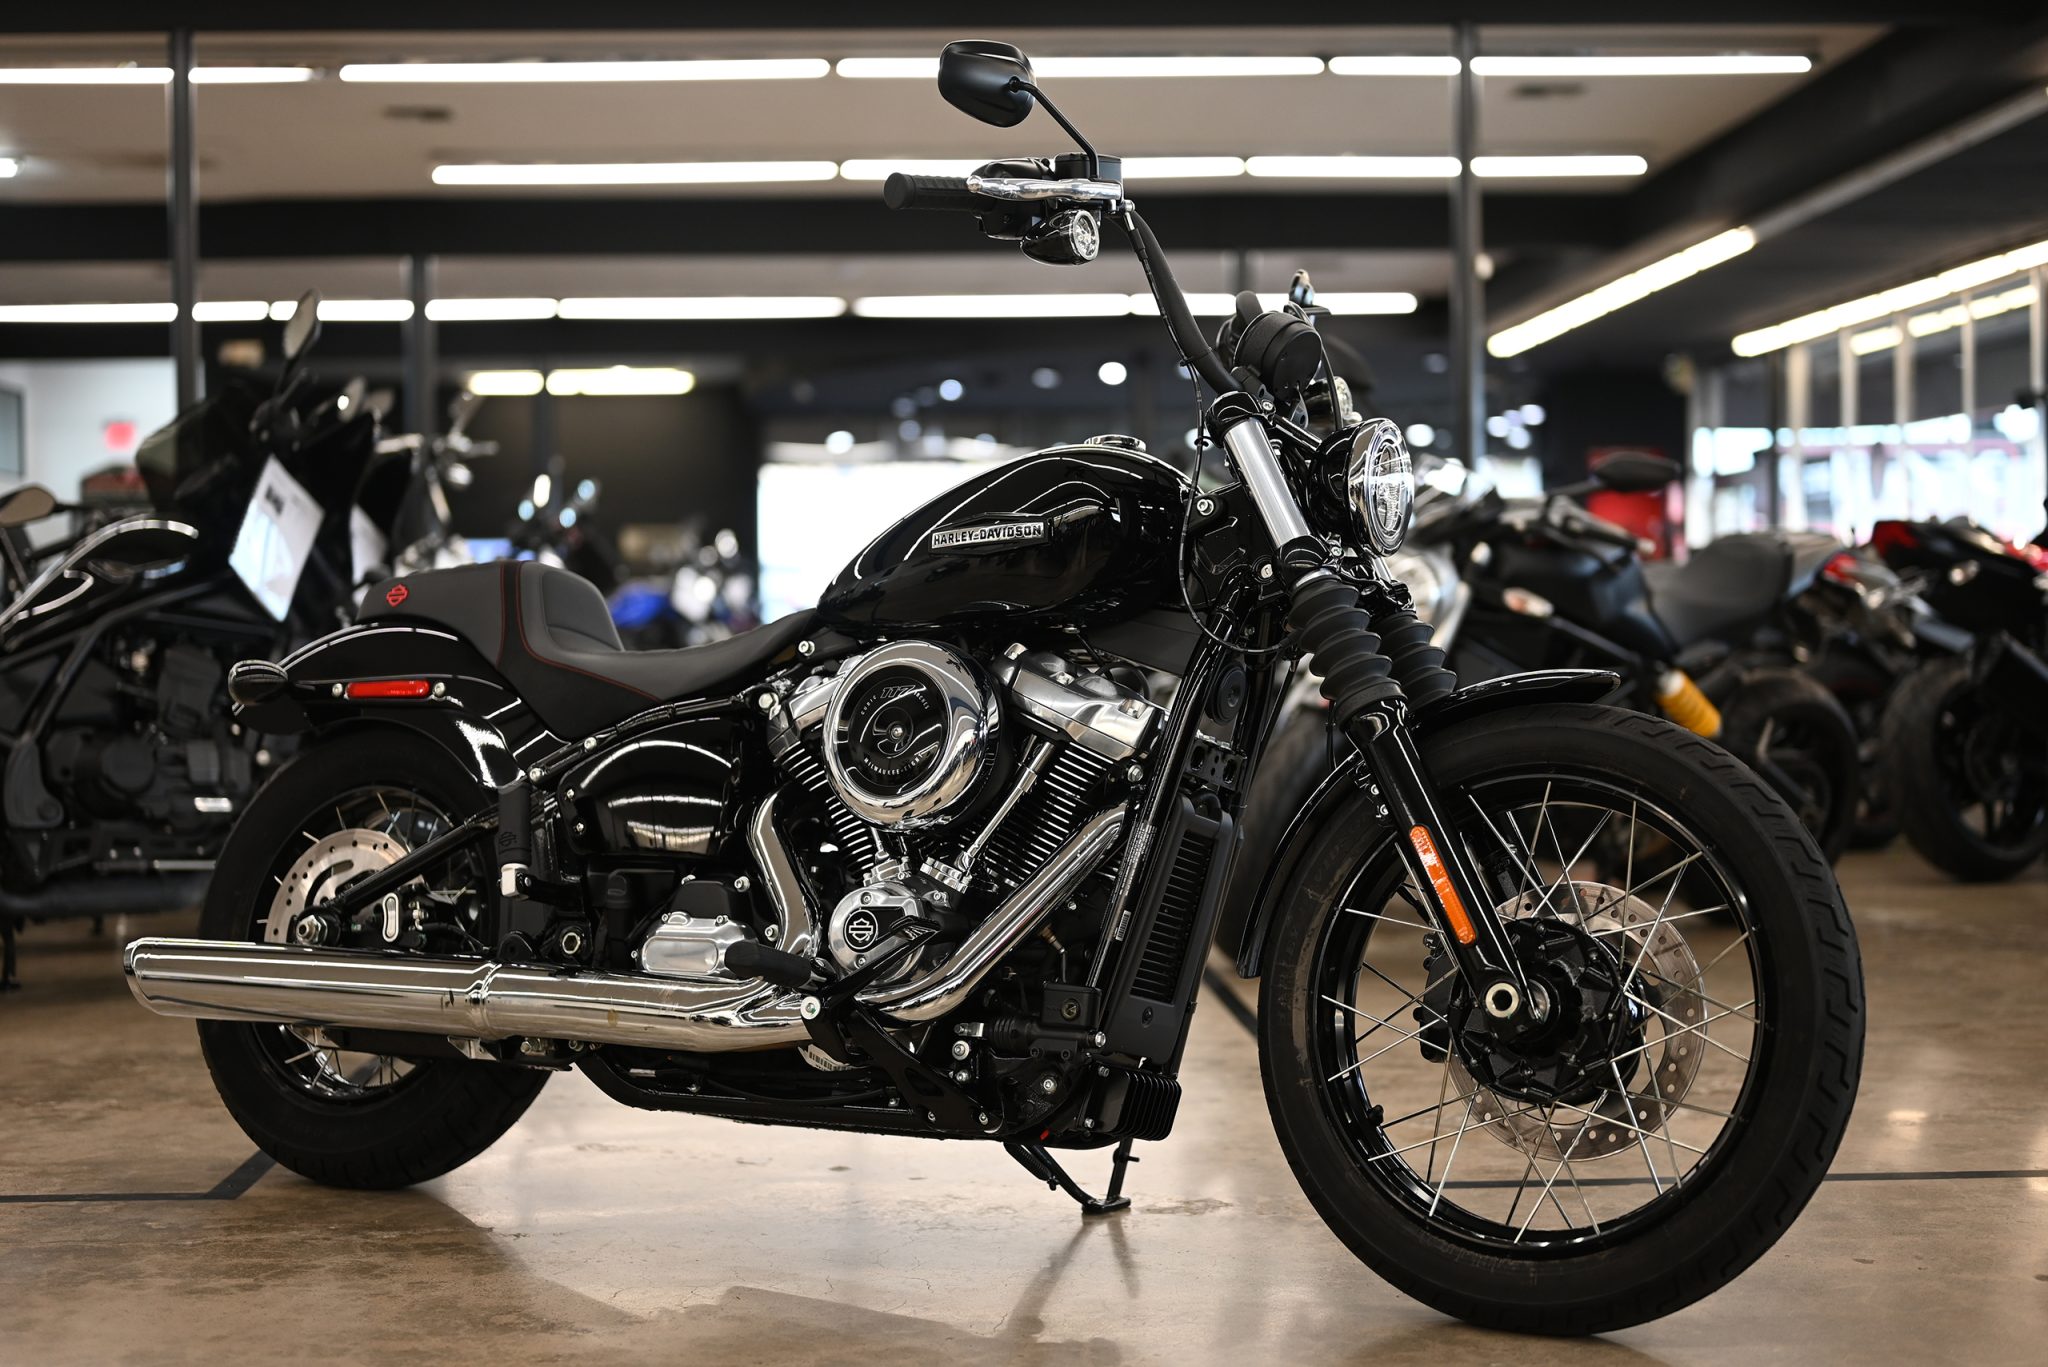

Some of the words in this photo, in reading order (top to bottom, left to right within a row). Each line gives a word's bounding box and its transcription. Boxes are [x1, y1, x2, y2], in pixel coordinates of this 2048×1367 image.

[933, 525, 1042, 546] HARLEY-DAVIDSON
[860, 695, 877, 715] CUBIC
[880, 684, 916, 699] 117
